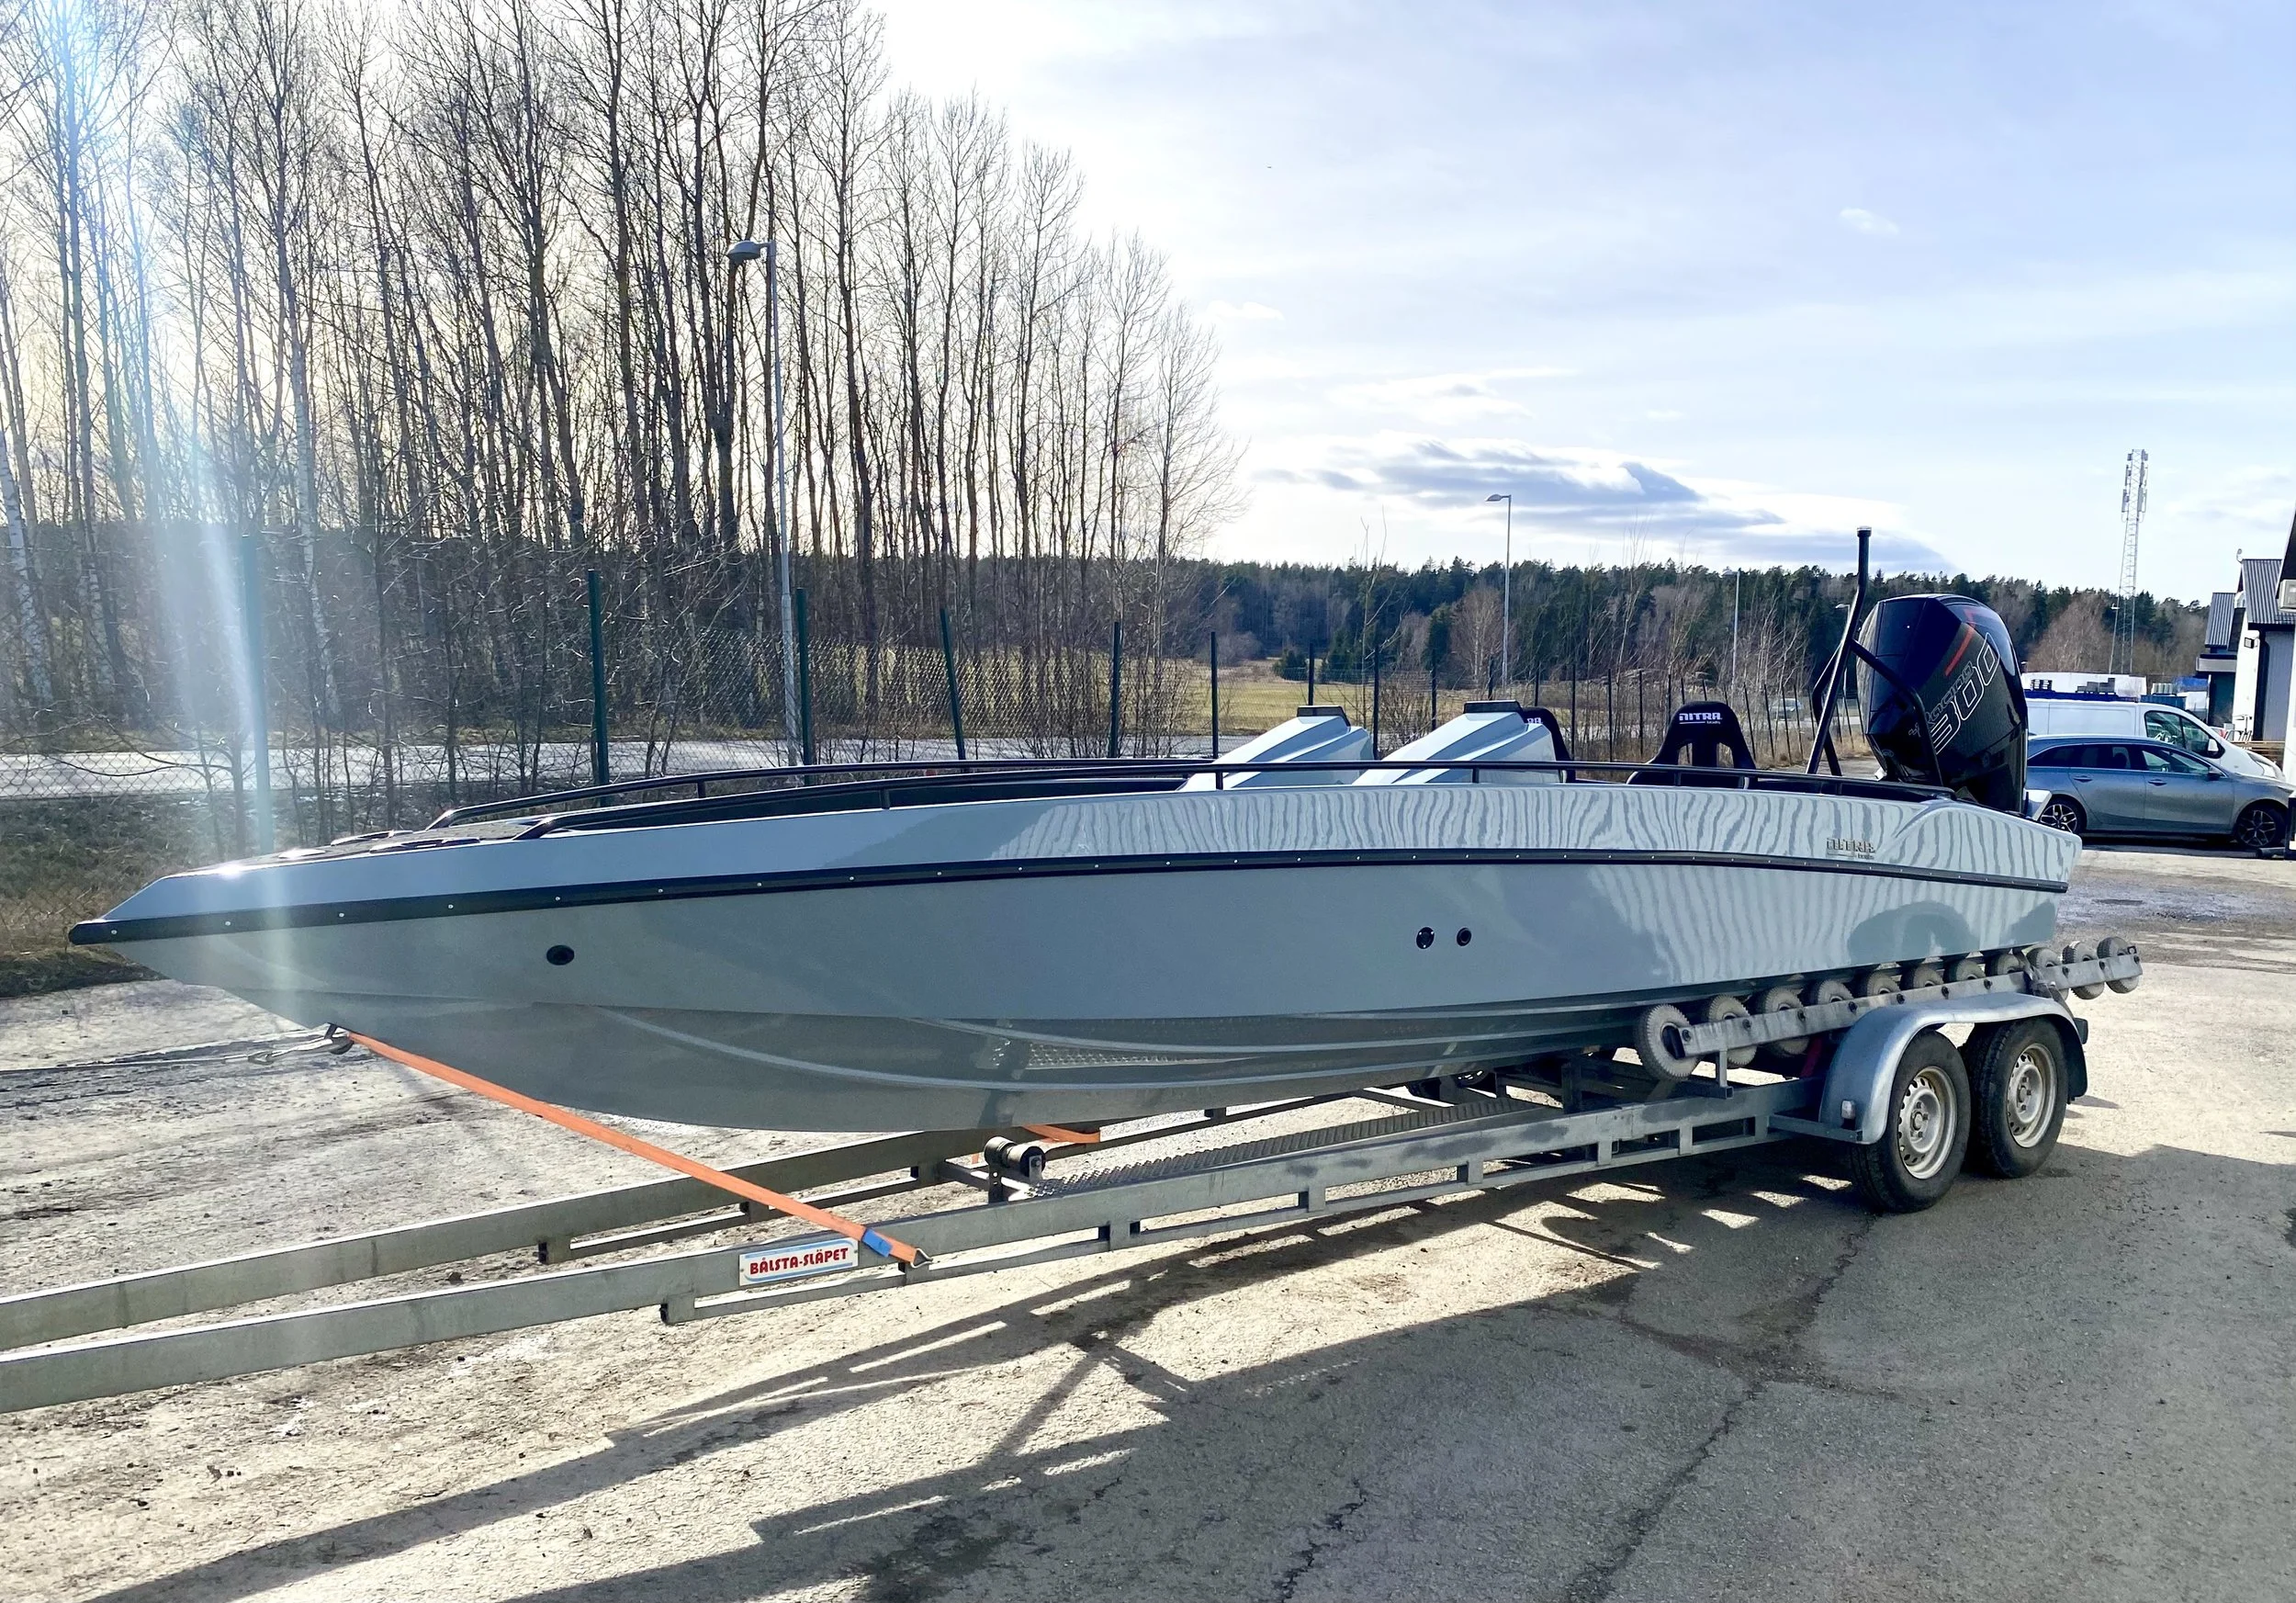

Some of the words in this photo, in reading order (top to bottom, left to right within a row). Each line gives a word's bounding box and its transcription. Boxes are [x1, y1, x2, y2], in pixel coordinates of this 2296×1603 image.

[1930, 632, 2000, 755] 300
[1679, 712, 1722, 721] NITRA
[749, 1247, 850, 1275] BÅLSTA-SLÄPET
